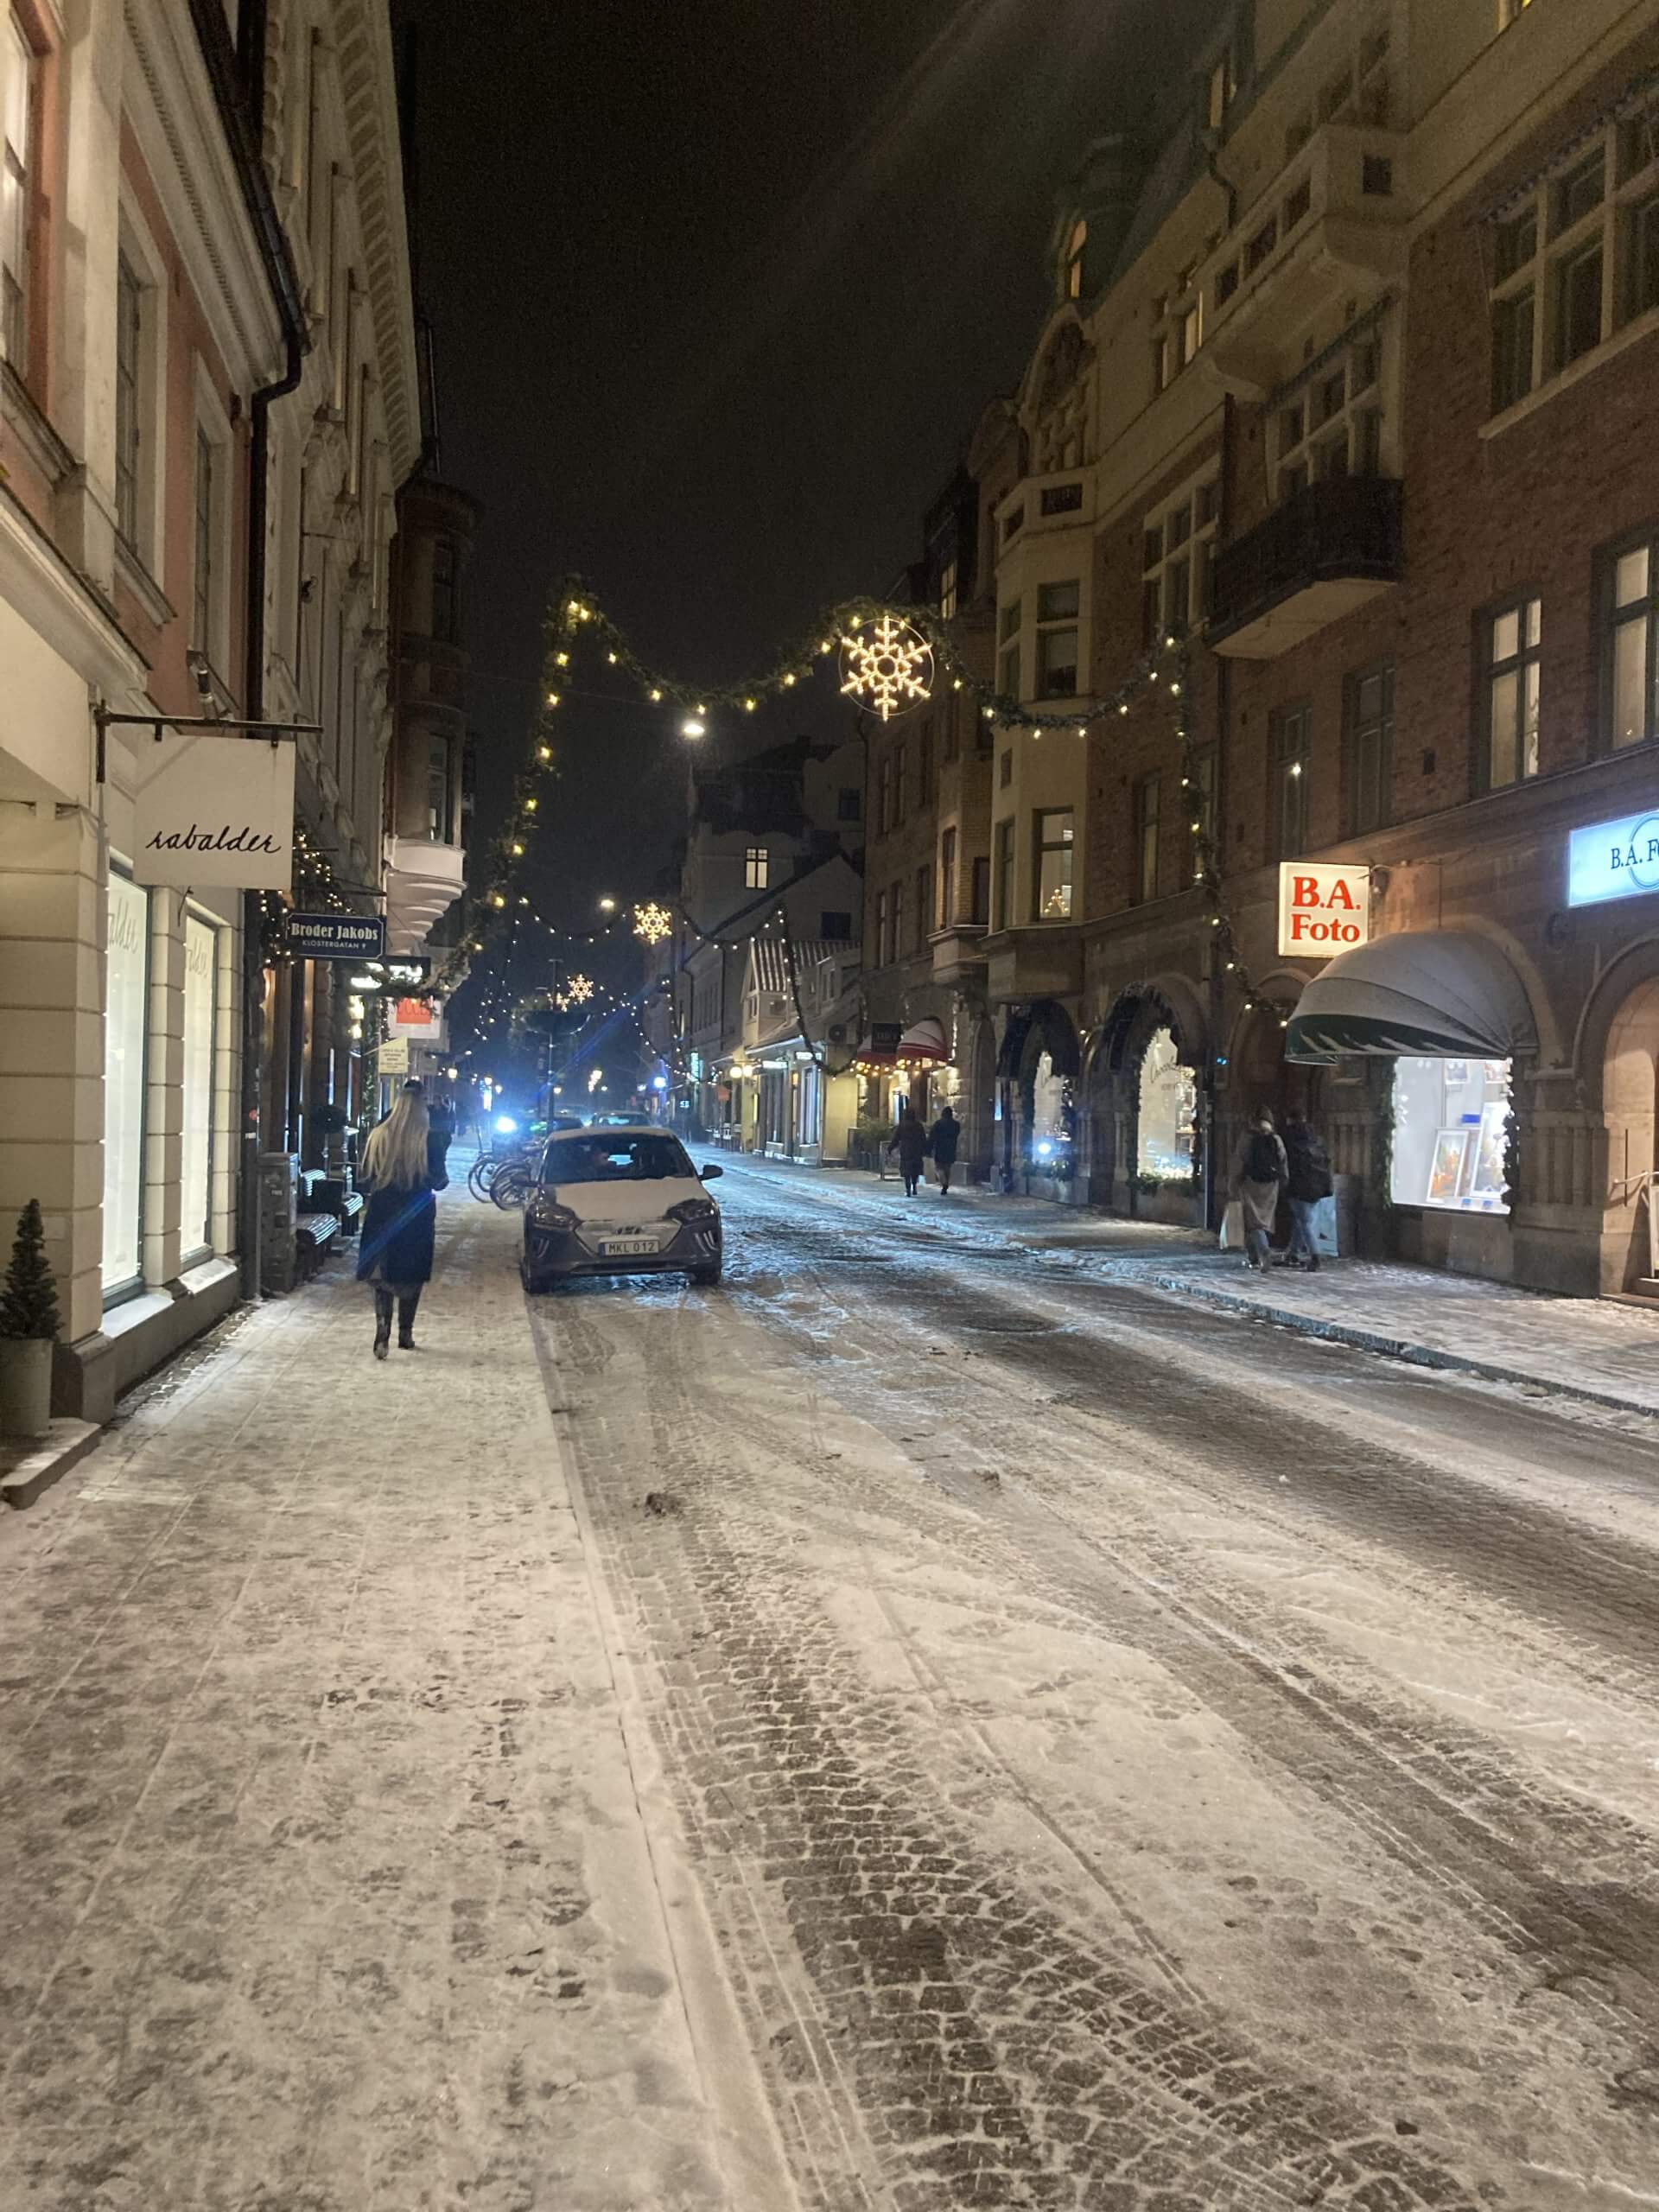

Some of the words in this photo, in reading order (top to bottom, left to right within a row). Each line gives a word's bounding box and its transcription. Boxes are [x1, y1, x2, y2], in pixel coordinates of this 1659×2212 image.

[145, 823, 282, 854] rabalder
[1610, 842, 1643, 870] B.A.
[1292, 876, 1362, 910] B.A.
[291, 922, 334, 938] Broder
[335, 925, 379, 941] Jakobs
[1291, 913, 1361, 942] Foto
[302, 939, 359, 949] KLOSTERGATAN
[608, 1243, 630, 1254] MKL
[632, 1242, 655, 1252] 012
